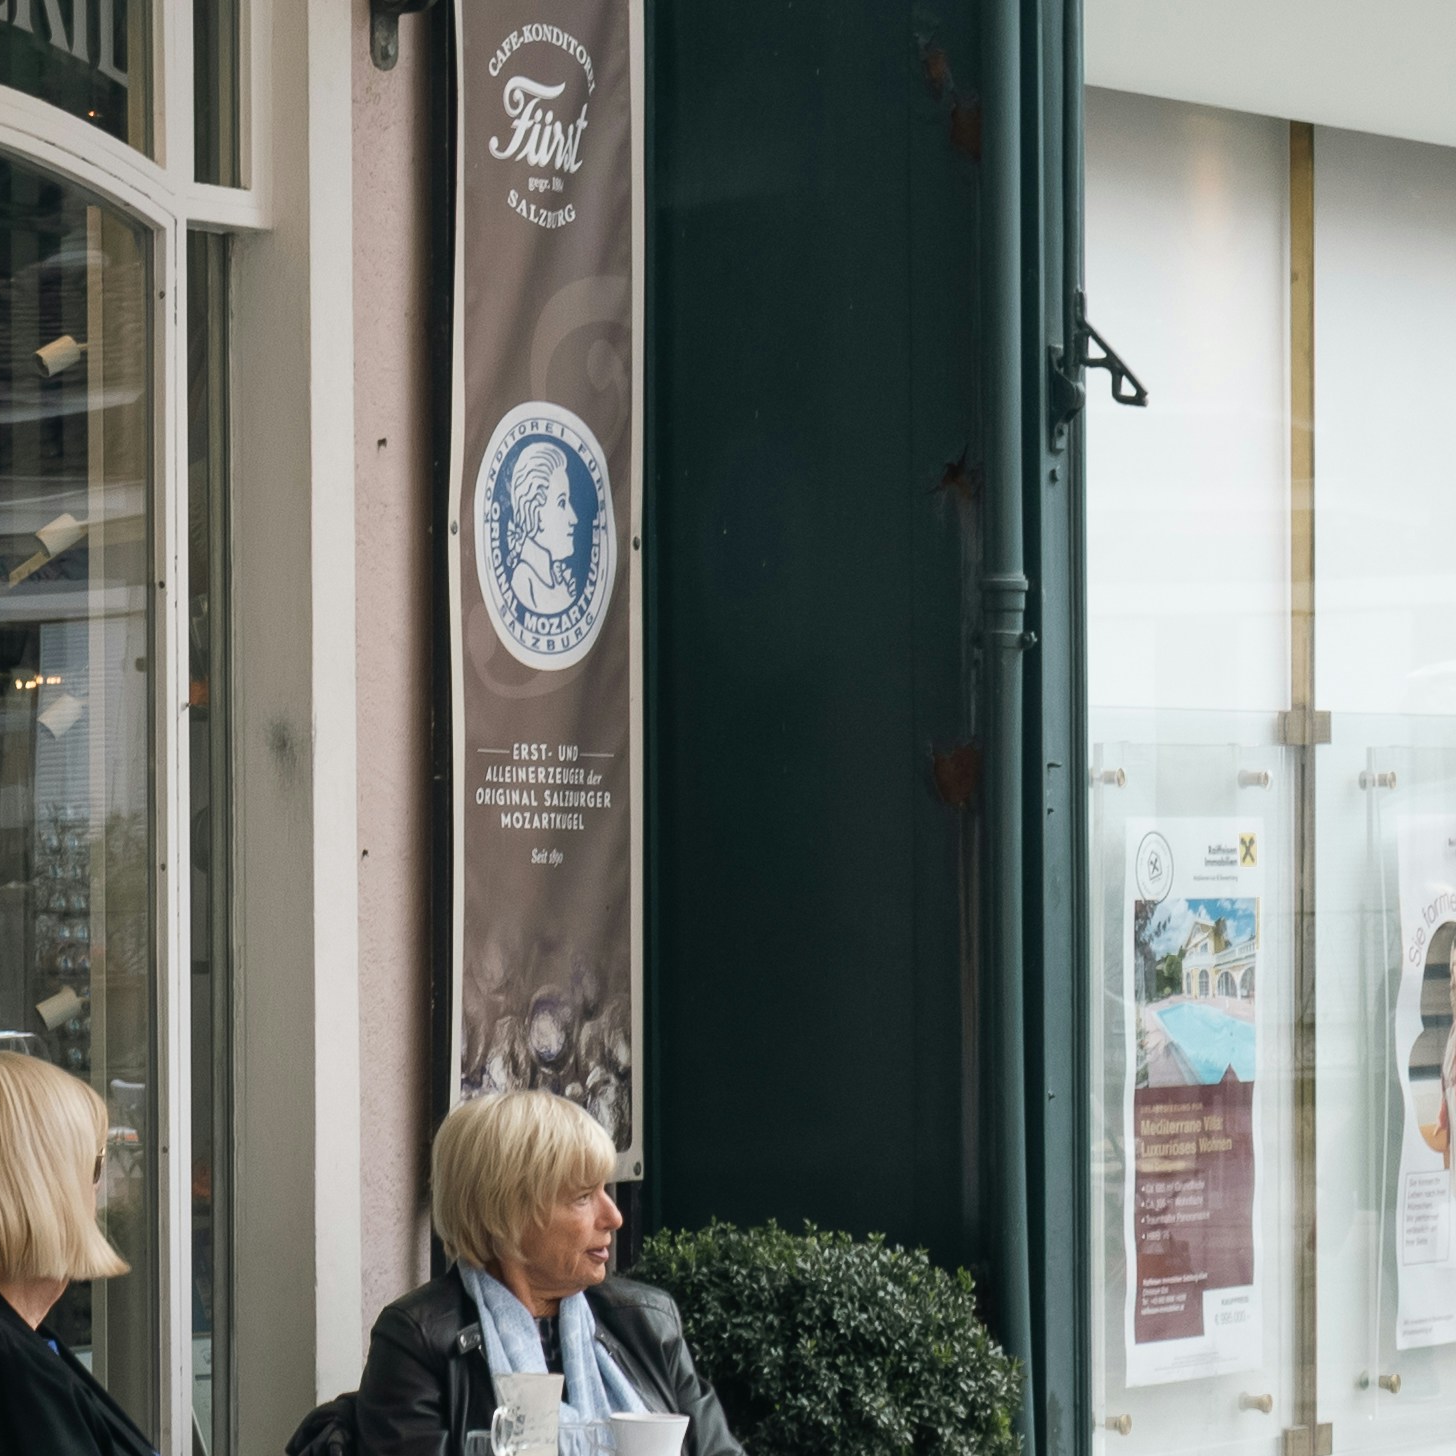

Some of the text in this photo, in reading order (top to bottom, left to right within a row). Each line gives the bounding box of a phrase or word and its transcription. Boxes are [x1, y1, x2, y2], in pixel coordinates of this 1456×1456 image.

[489, 76, 588, 174] Fürst
[507, 189, 576, 229] SALZBURG
[484, 421, 565, 524] KONDITOREI
[491, 502, 520, 619] ORIGINAL
[500, 605, 593, 651] SALZBURG
[513, 743, 578, 761] ERST- UND
[485, 766, 602, 785] ALLEINERZEUGER der
[476, 787, 611, 808] ORIGINAL SALZBURGER
[501, 812, 584, 830] MOZARTKUGEL
[531, 848, 548, 864] Seit
